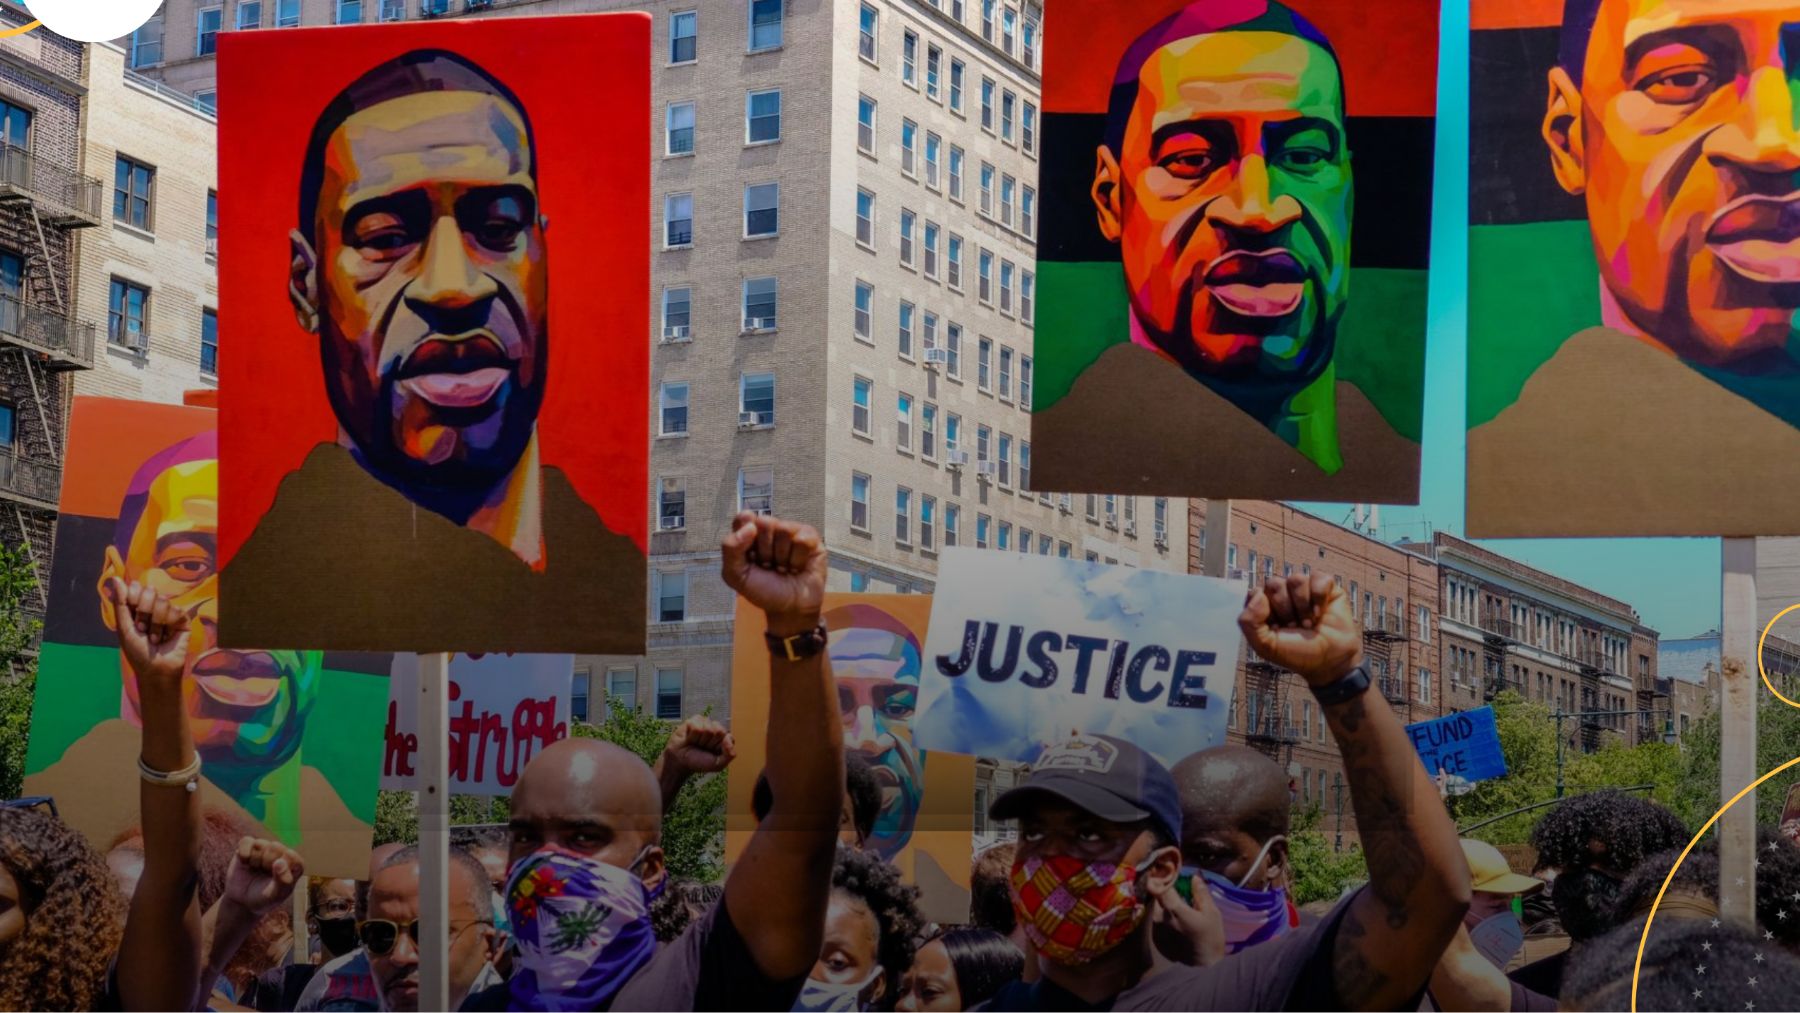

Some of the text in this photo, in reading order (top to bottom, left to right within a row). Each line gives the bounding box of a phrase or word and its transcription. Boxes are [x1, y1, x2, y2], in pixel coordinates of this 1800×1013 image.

[935, 619, 1217, 710] JUSTICE
[383, 700, 418, 777] he
[1407, 716, 1473, 750] FUND
